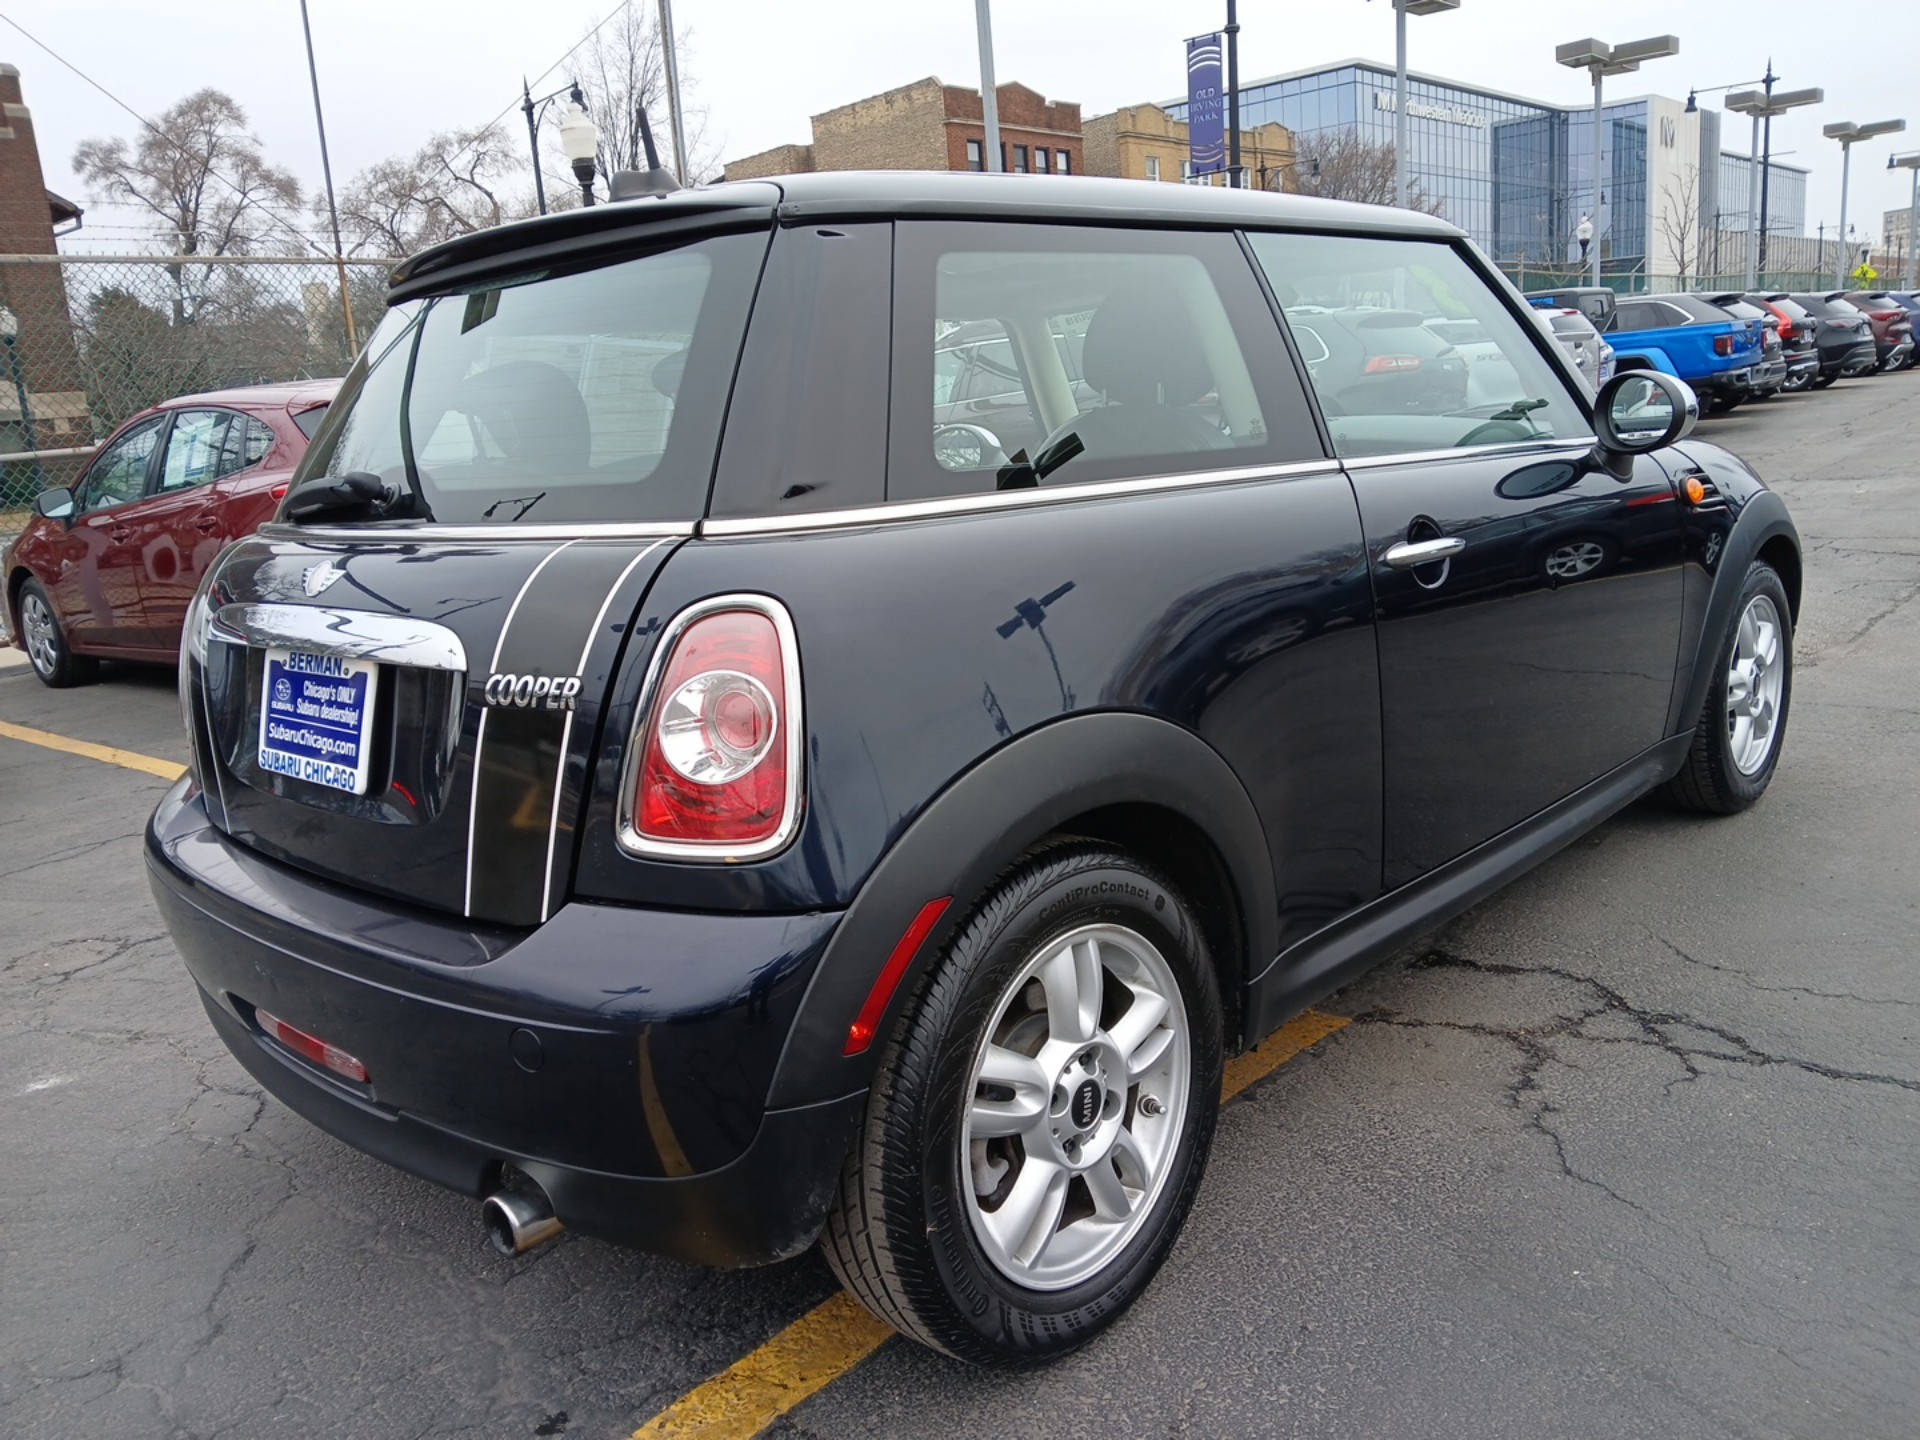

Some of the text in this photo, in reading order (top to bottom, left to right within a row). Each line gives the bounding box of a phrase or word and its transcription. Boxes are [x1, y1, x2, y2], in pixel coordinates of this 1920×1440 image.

[1191, 98, 1221, 112] IRVING
[1196, 88, 1215, 99] OLD
[1194, 112, 1218, 123] PARK
[288, 652, 342, 676] BERMAN
[303, 680, 356, 704] Chicago's ONLY
[485, 674, 581, 709] COOPER
[296, 698, 359, 728] Subaru dealership!
[269, 722, 356, 756] SubaruChicago.com
[260, 750, 356, 791] SUBARU CHICAGO
[1038, 881, 1150, 921] ContiProContact
[1082, 1086, 1093, 1123] MINI
